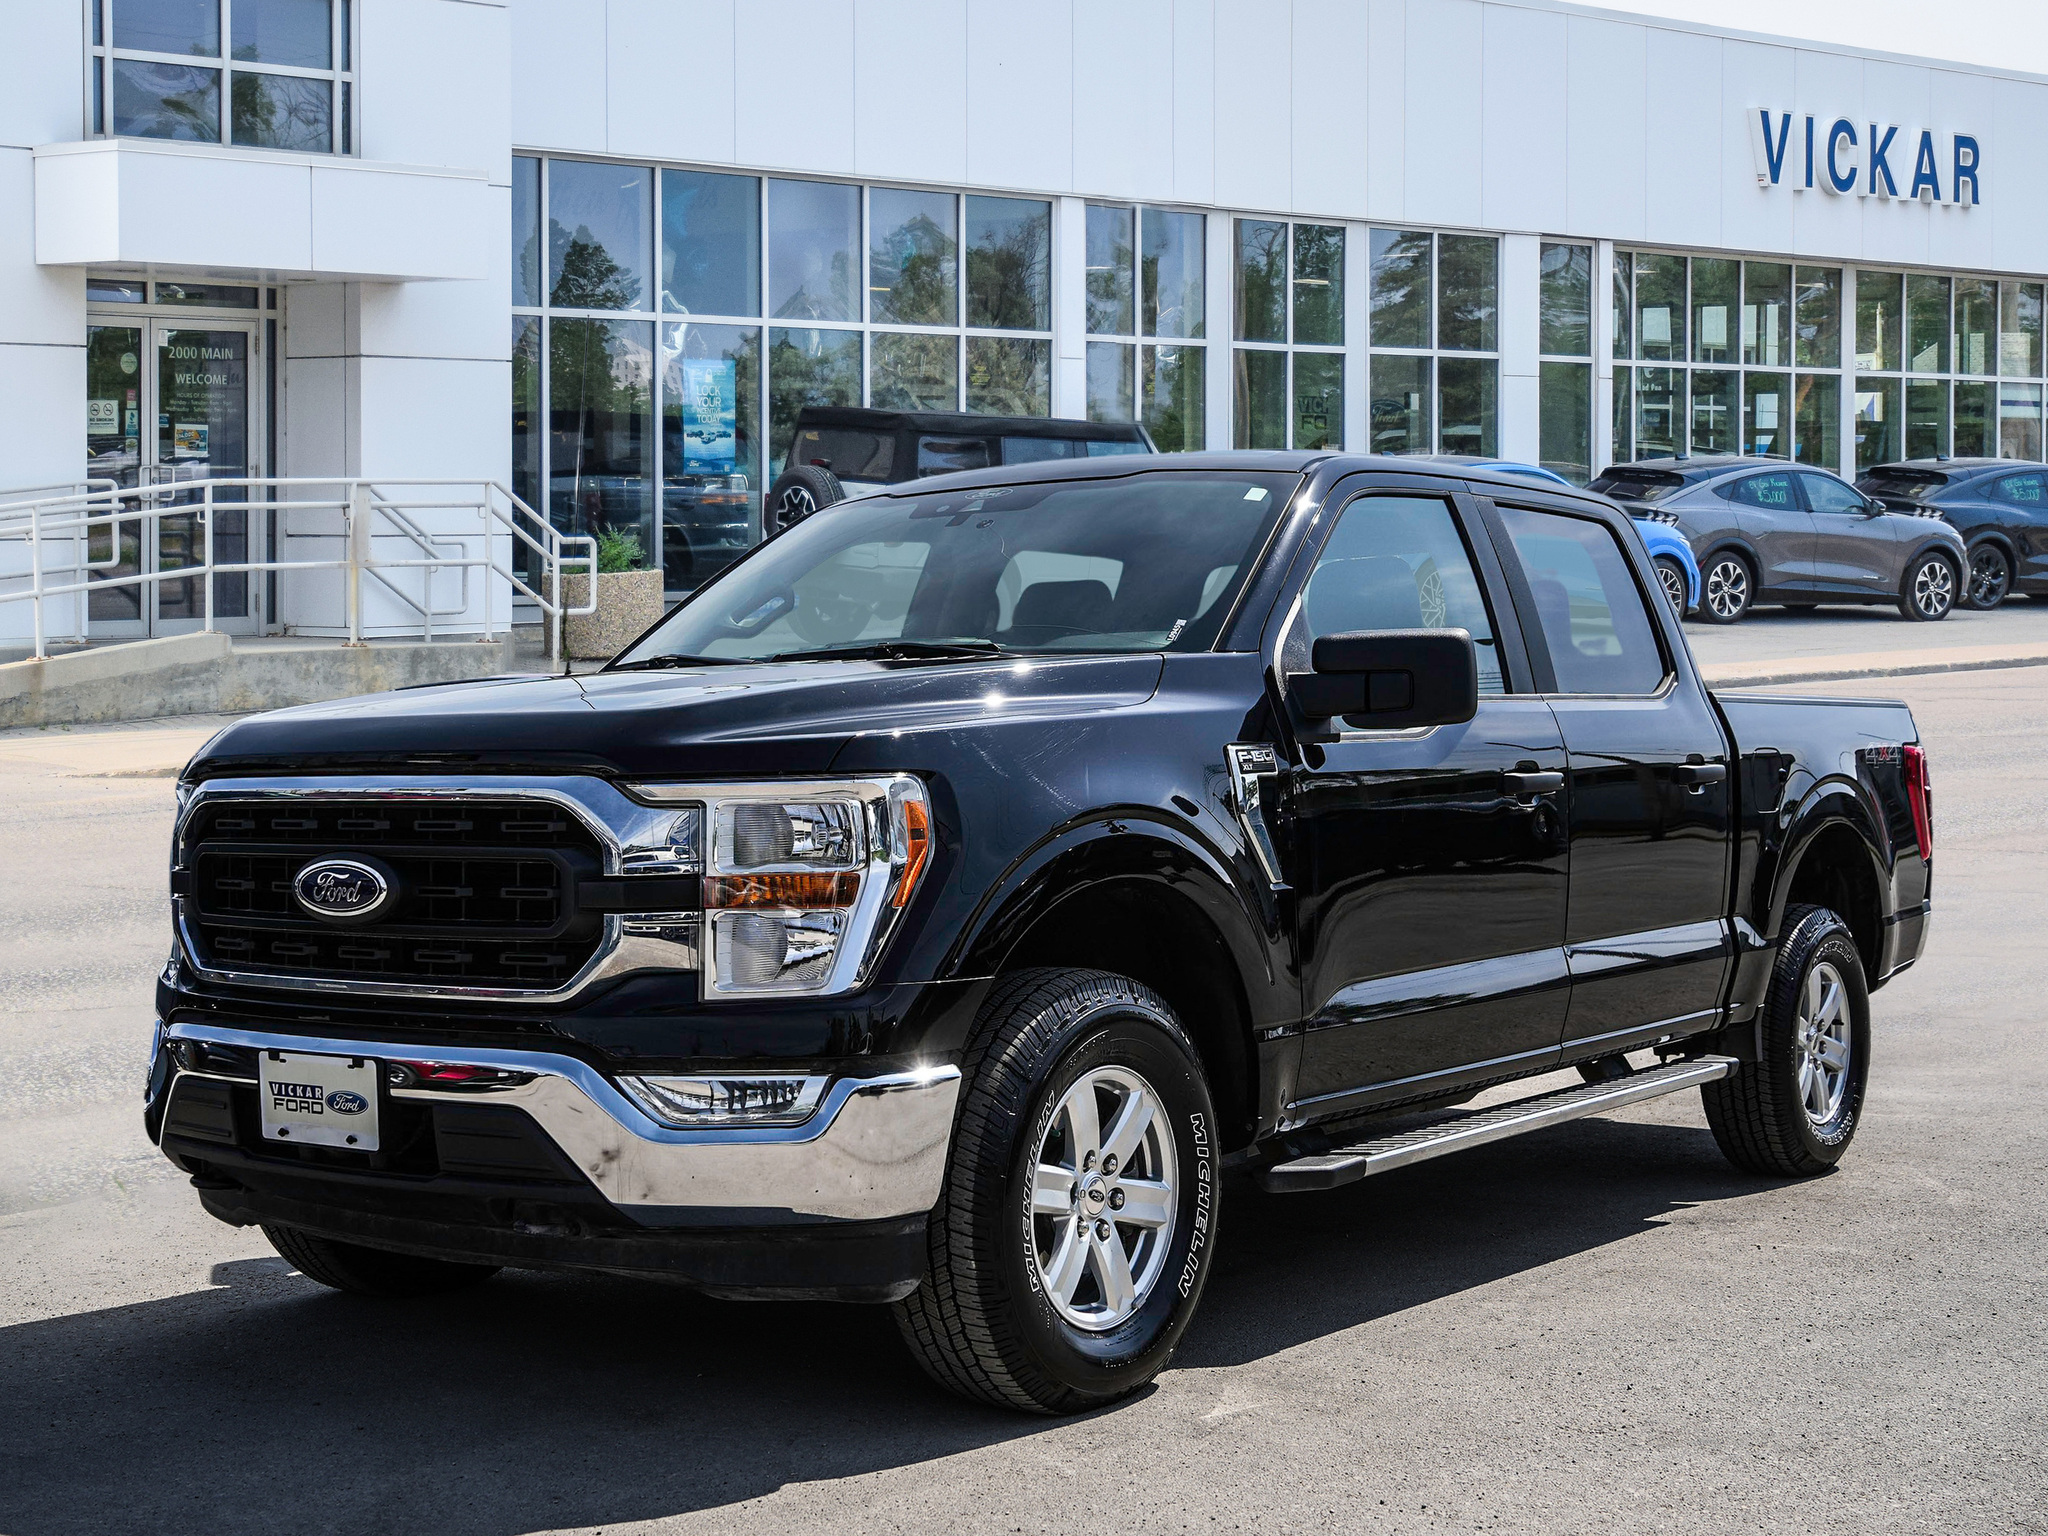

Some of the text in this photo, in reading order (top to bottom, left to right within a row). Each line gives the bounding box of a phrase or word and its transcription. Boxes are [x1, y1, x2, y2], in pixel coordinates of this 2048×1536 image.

[1757, 108, 1980, 206] VICKAR
[168, 346, 234, 360] 2000 MAIN
[175, 373, 228, 385] WELCOME
[696, 385, 721, 396] LOCK
[696, 396, 722, 407] YOUR
[697, 414, 721, 423] TODAY
[1757, 489, 1787, 504] $5,000
[1236, 750, 1274, 763] F-150
[313, 871, 362, 903] Ford
[271, 1083, 323, 1100] VICKAR
[273, 1097, 324, 1115] FORD
[333, 1093, 361, 1112] Ford
[1021, 1090, 1056, 1293] MICHELIN
[1178, 1112, 1212, 1299] MICHELIN
